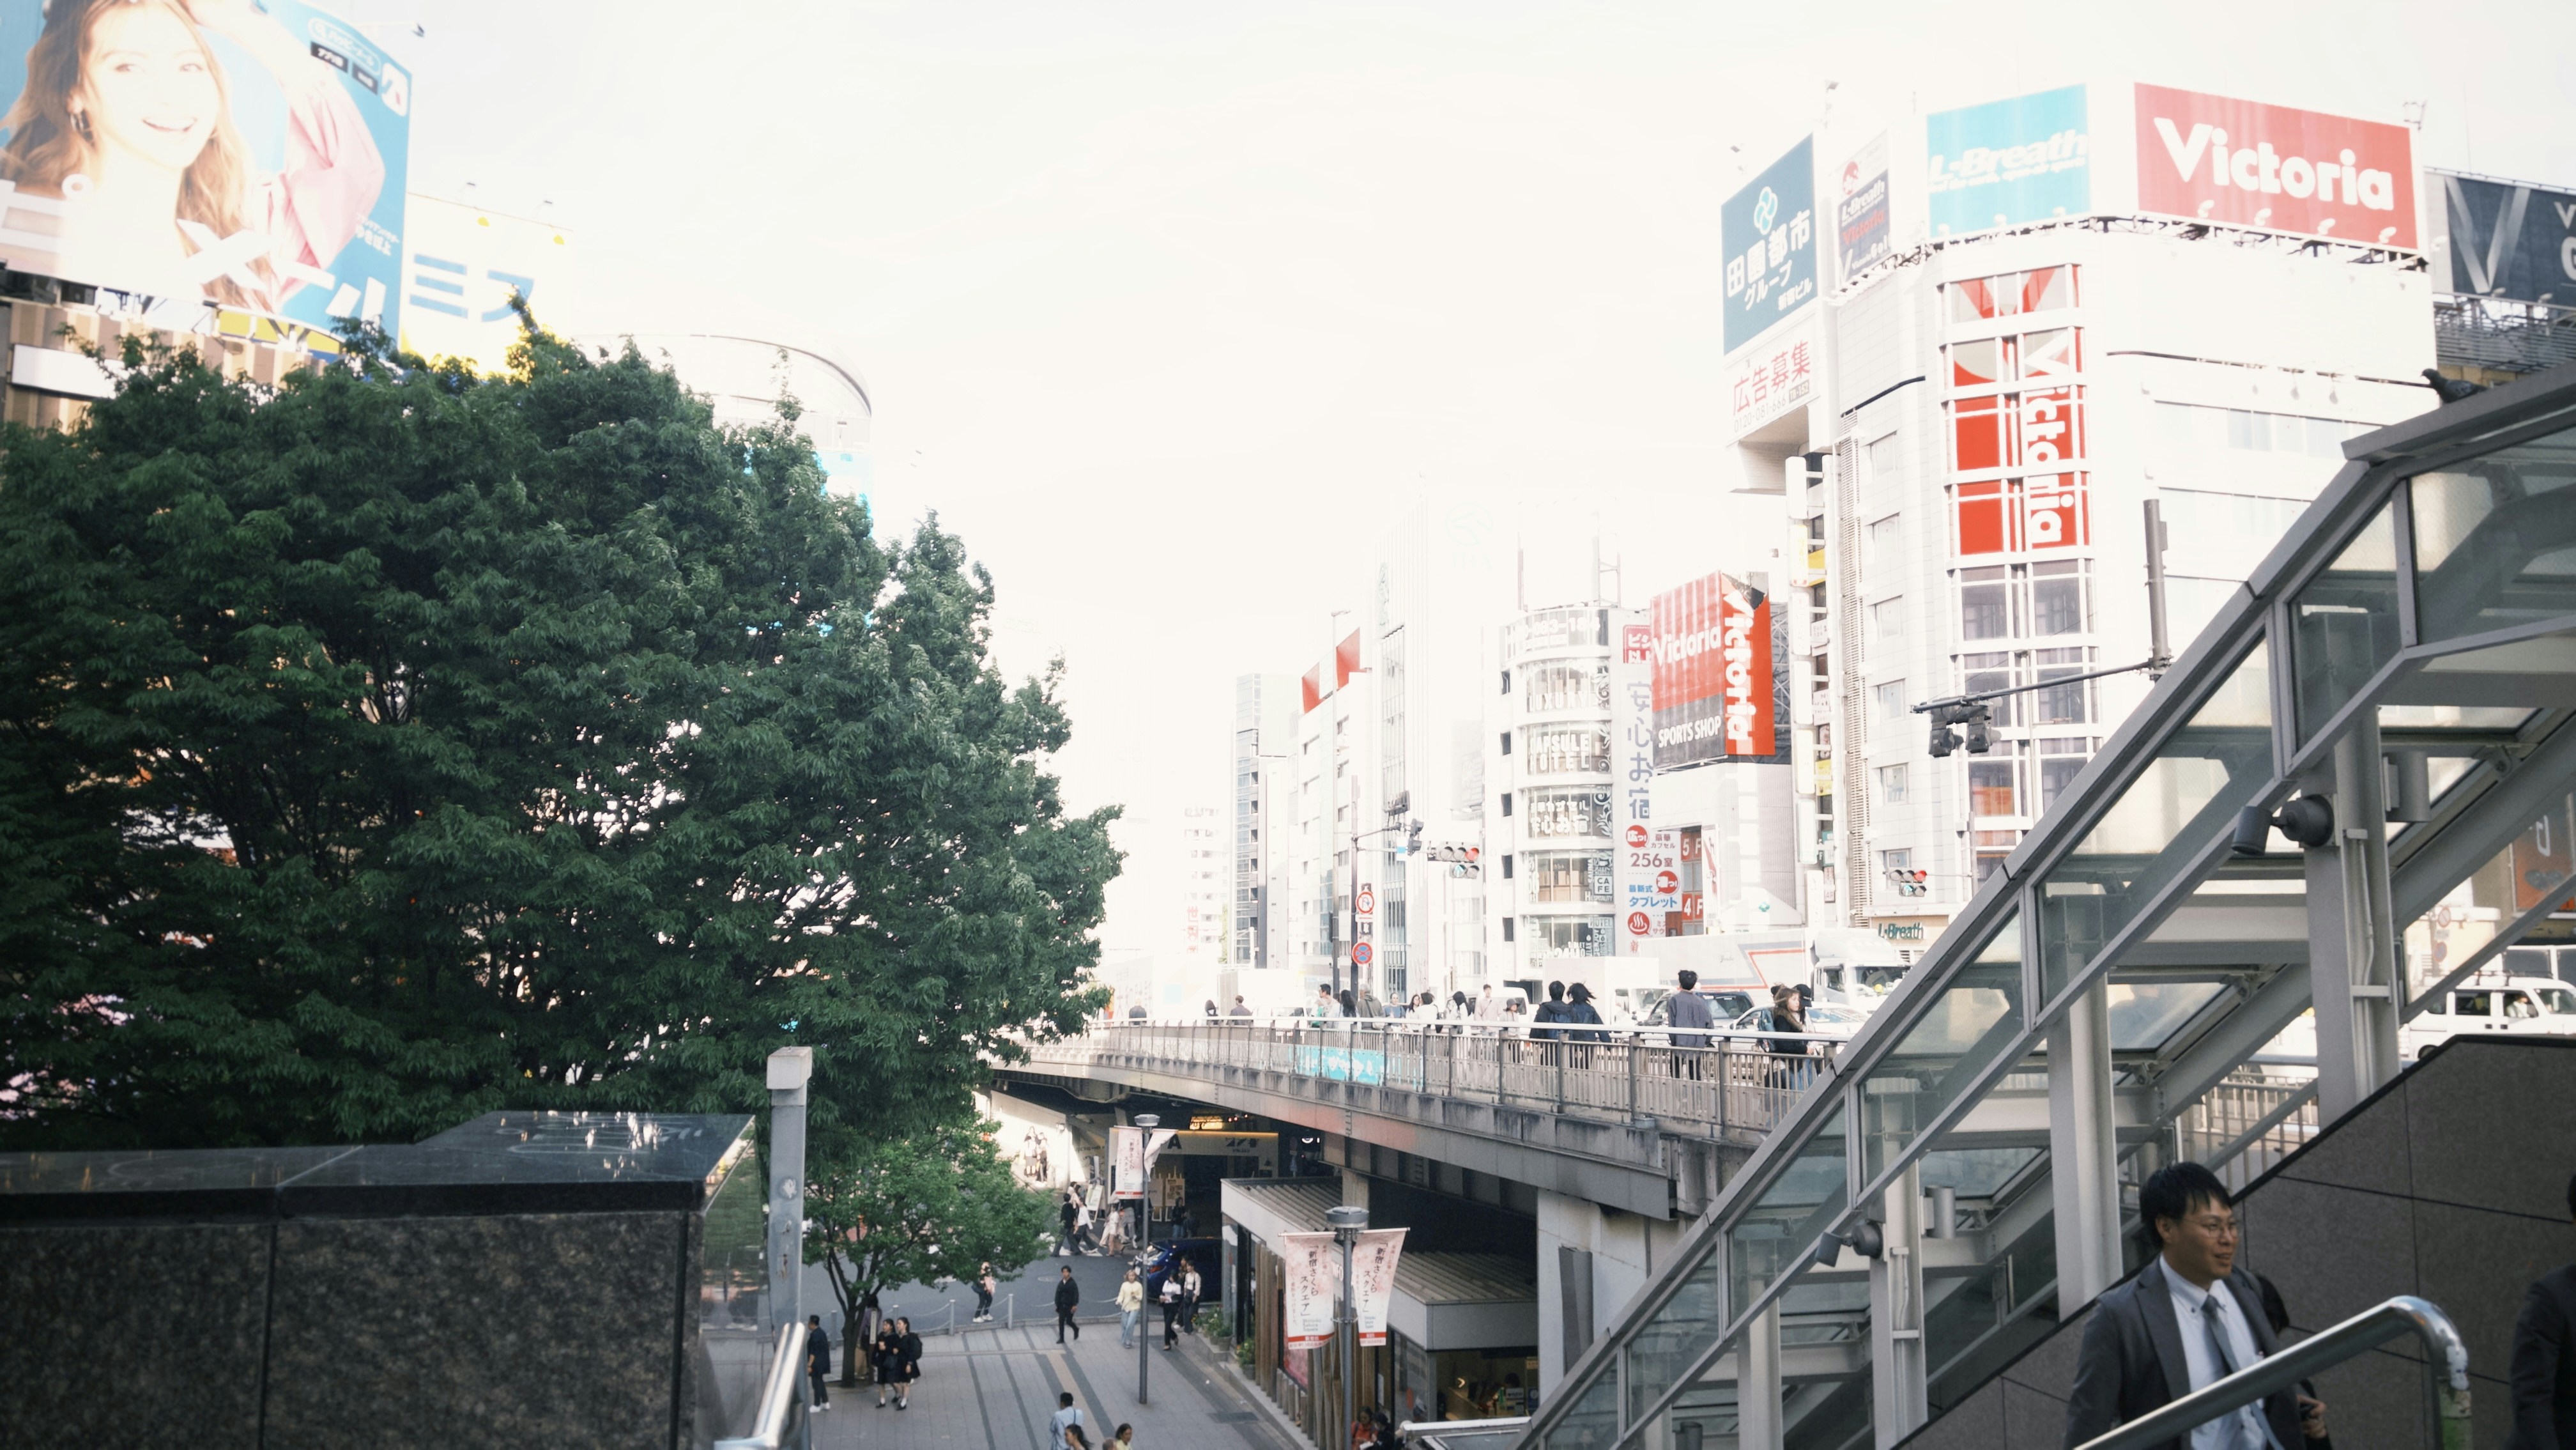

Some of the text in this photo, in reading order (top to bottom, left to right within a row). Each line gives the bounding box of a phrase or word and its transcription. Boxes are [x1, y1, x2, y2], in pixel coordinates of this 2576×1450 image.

[1929, 129, 2088, 183] L-Breath
[2153, 116, 2394, 211] Victoria
[1842, 210, 1885, 246] Victoria
[1727, 208, 1811, 298] 田園都市
[1744, 263, 1793, 311] グループ
[1733, 339, 1811, 416] 広告募集
[1734, 393, 1786, 433] 0120-081-666
[1652, 621, 1722, 668] Victoria
[1723, 590, 1756, 741] Victoria
[1528, 691, 1588, 712] LUXURY
[1529, 734, 1590, 754] CAPSULE
[1658, 715, 1722, 748] SPORTS SHOP
[1529, 752, 1590, 772] HOTEL
[1629, 895, 1678, 908] タブレット
[1308, 1244, 1319, 1297] 「新宿さくら
[1370, 1241, 1388, 1293] 「新宿さくら
[1300, 1276, 1310, 1316] スクエア」
